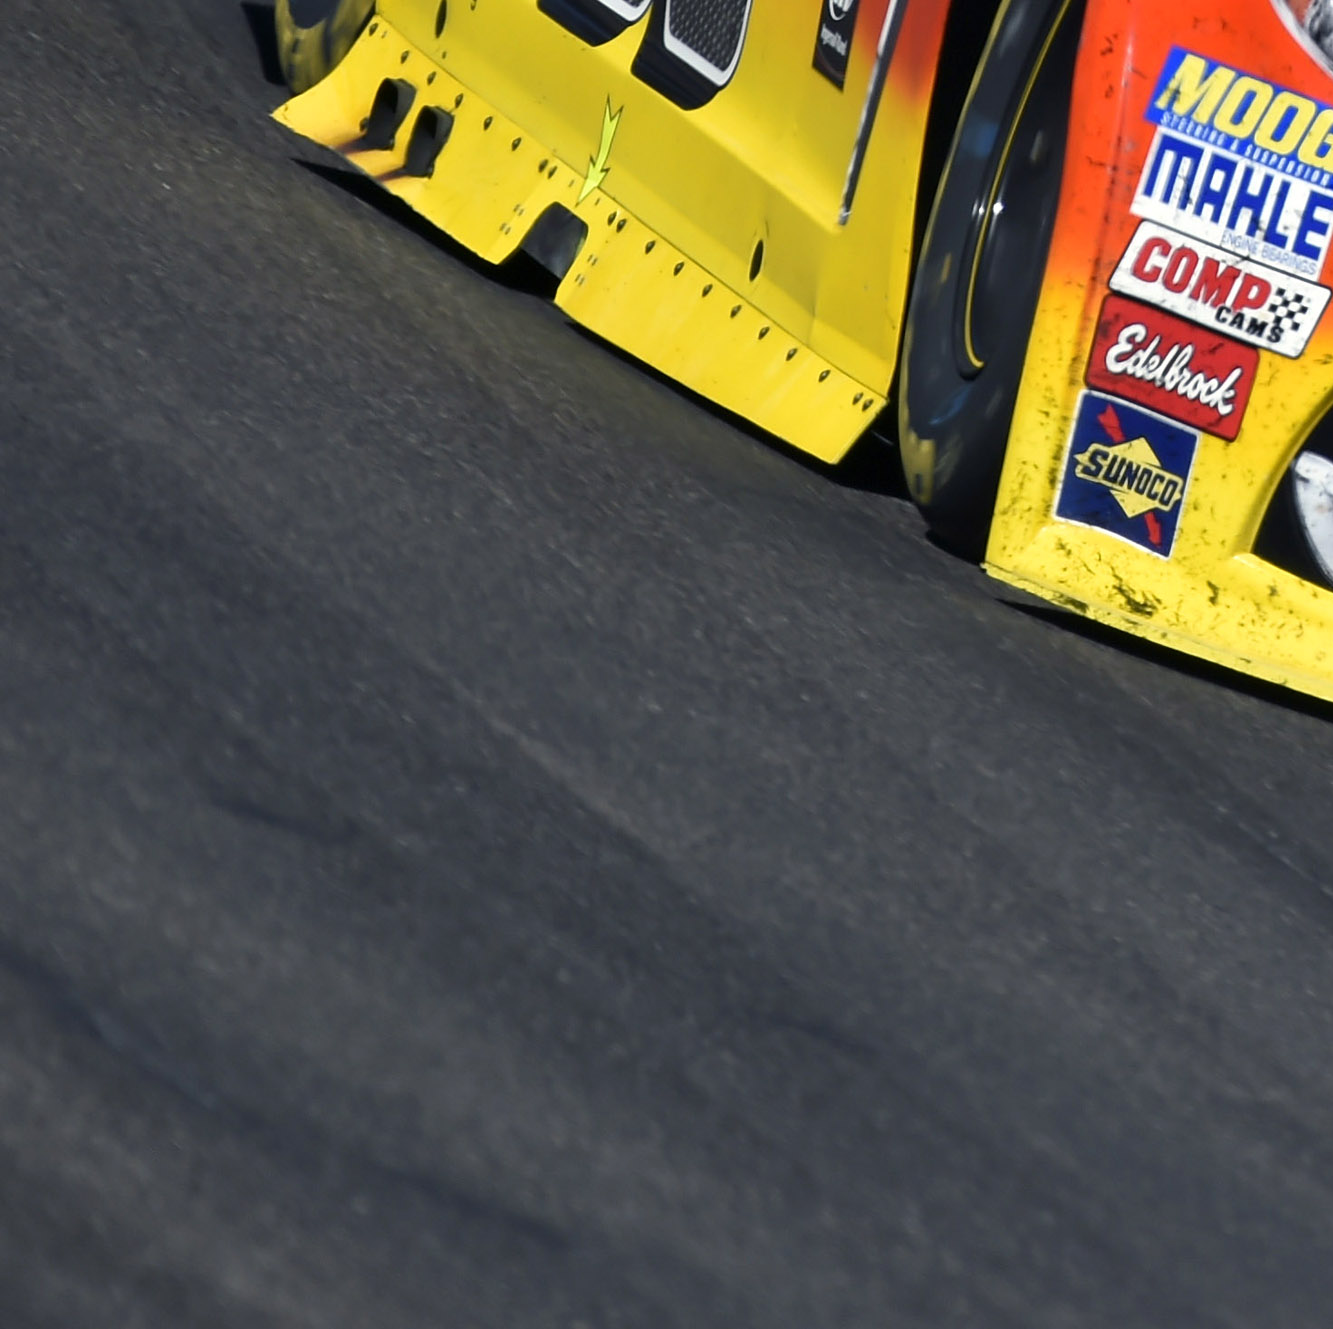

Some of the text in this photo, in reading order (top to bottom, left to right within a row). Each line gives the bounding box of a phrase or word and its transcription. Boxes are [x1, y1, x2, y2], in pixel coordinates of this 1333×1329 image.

[1243, 143, 1332, 187] SUSPENSION
[1130, 235, 1273, 312] COMP
[1221, 229, 1318, 276] ENGINE BEARINGS
[1214, 304, 1285, 344] CAMS
[1104, 322, 1243, 416] Edelbrock
[1087, 449, 1185, 508] SUNOCO
